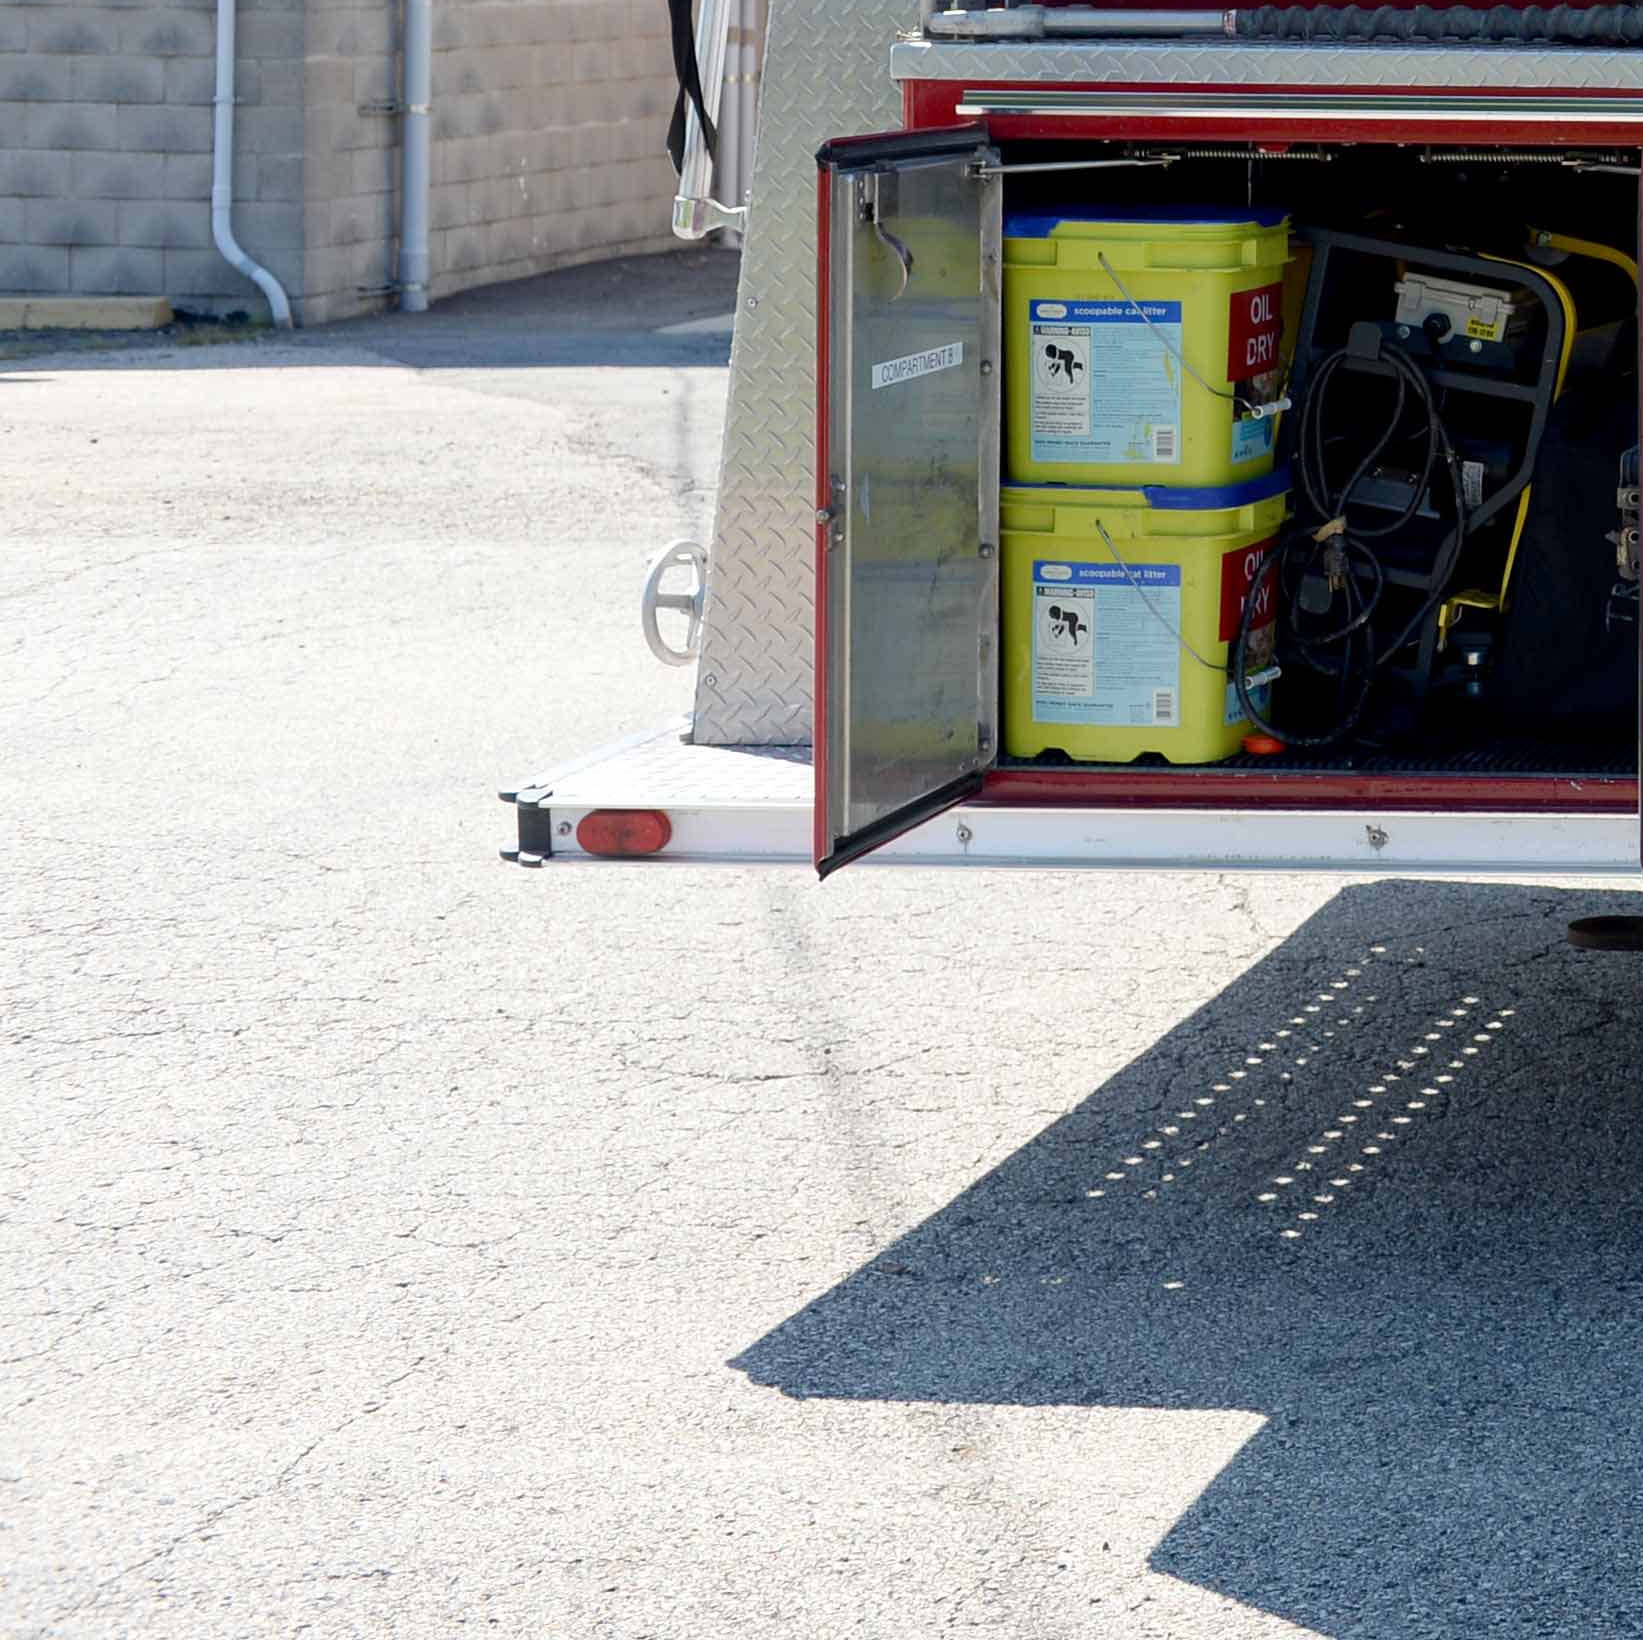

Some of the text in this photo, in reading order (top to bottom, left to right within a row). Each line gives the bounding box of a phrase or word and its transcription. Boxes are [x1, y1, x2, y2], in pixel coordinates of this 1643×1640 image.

[1073, 306, 1123, 317] scoopable
[1250, 294, 1273, 325] OIL
[1246, 332, 1275, 366] DRY
[881, 349, 947, 383] COMPARTMENT
[1078, 569, 1125, 580] scoopable
